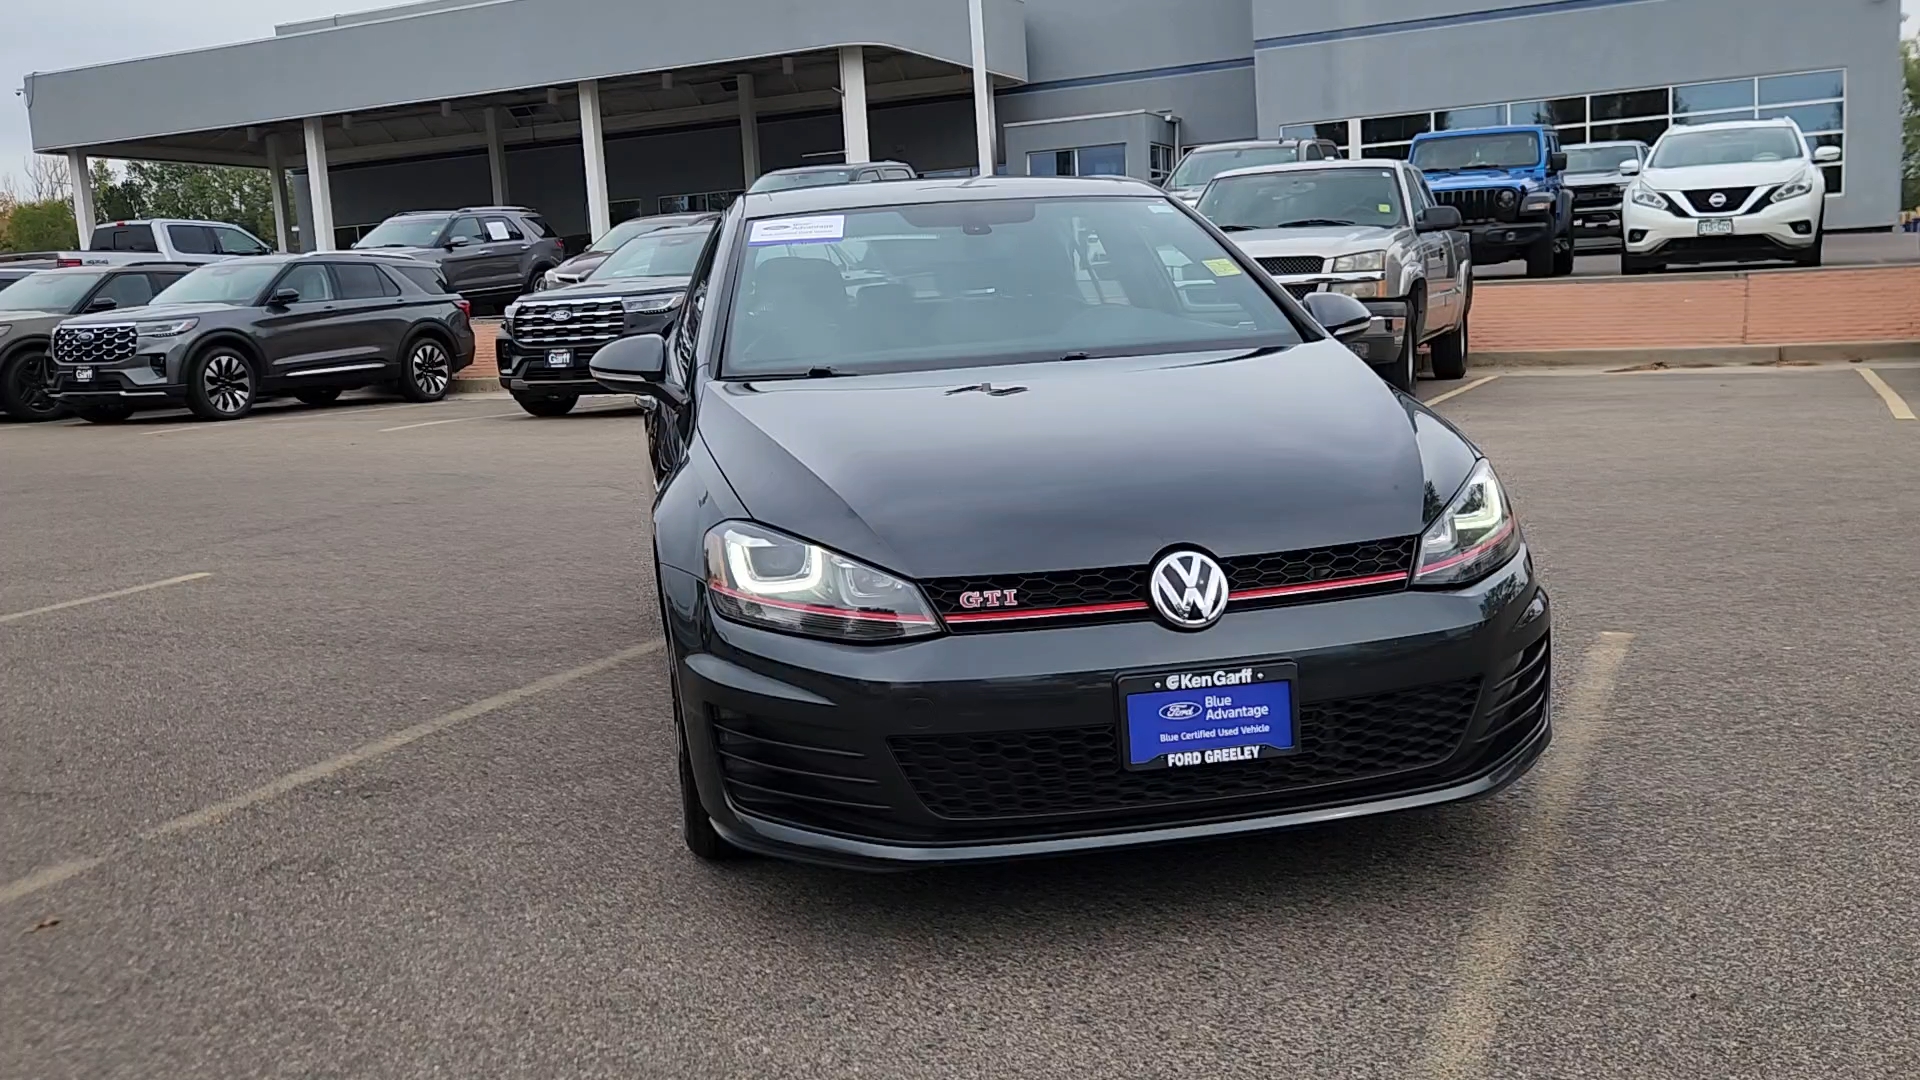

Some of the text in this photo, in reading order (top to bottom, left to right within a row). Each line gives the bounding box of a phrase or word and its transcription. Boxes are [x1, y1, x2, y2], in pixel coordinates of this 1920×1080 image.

[548, 353, 571, 364] Garff
[75, 369, 93, 379] Garff
[959, 589, 1018, 609] GTI
[1181, 668, 1253, 689] Ken Garff
[1166, 704, 1194, 717] Ford
[1204, 696, 1232, 708] Blue
[1205, 704, 1269, 721] Advantage
[1160, 723, 1270, 743] Blue Certified Used Vehicle
[1167, 745, 1260, 767] FORD GREELEY
